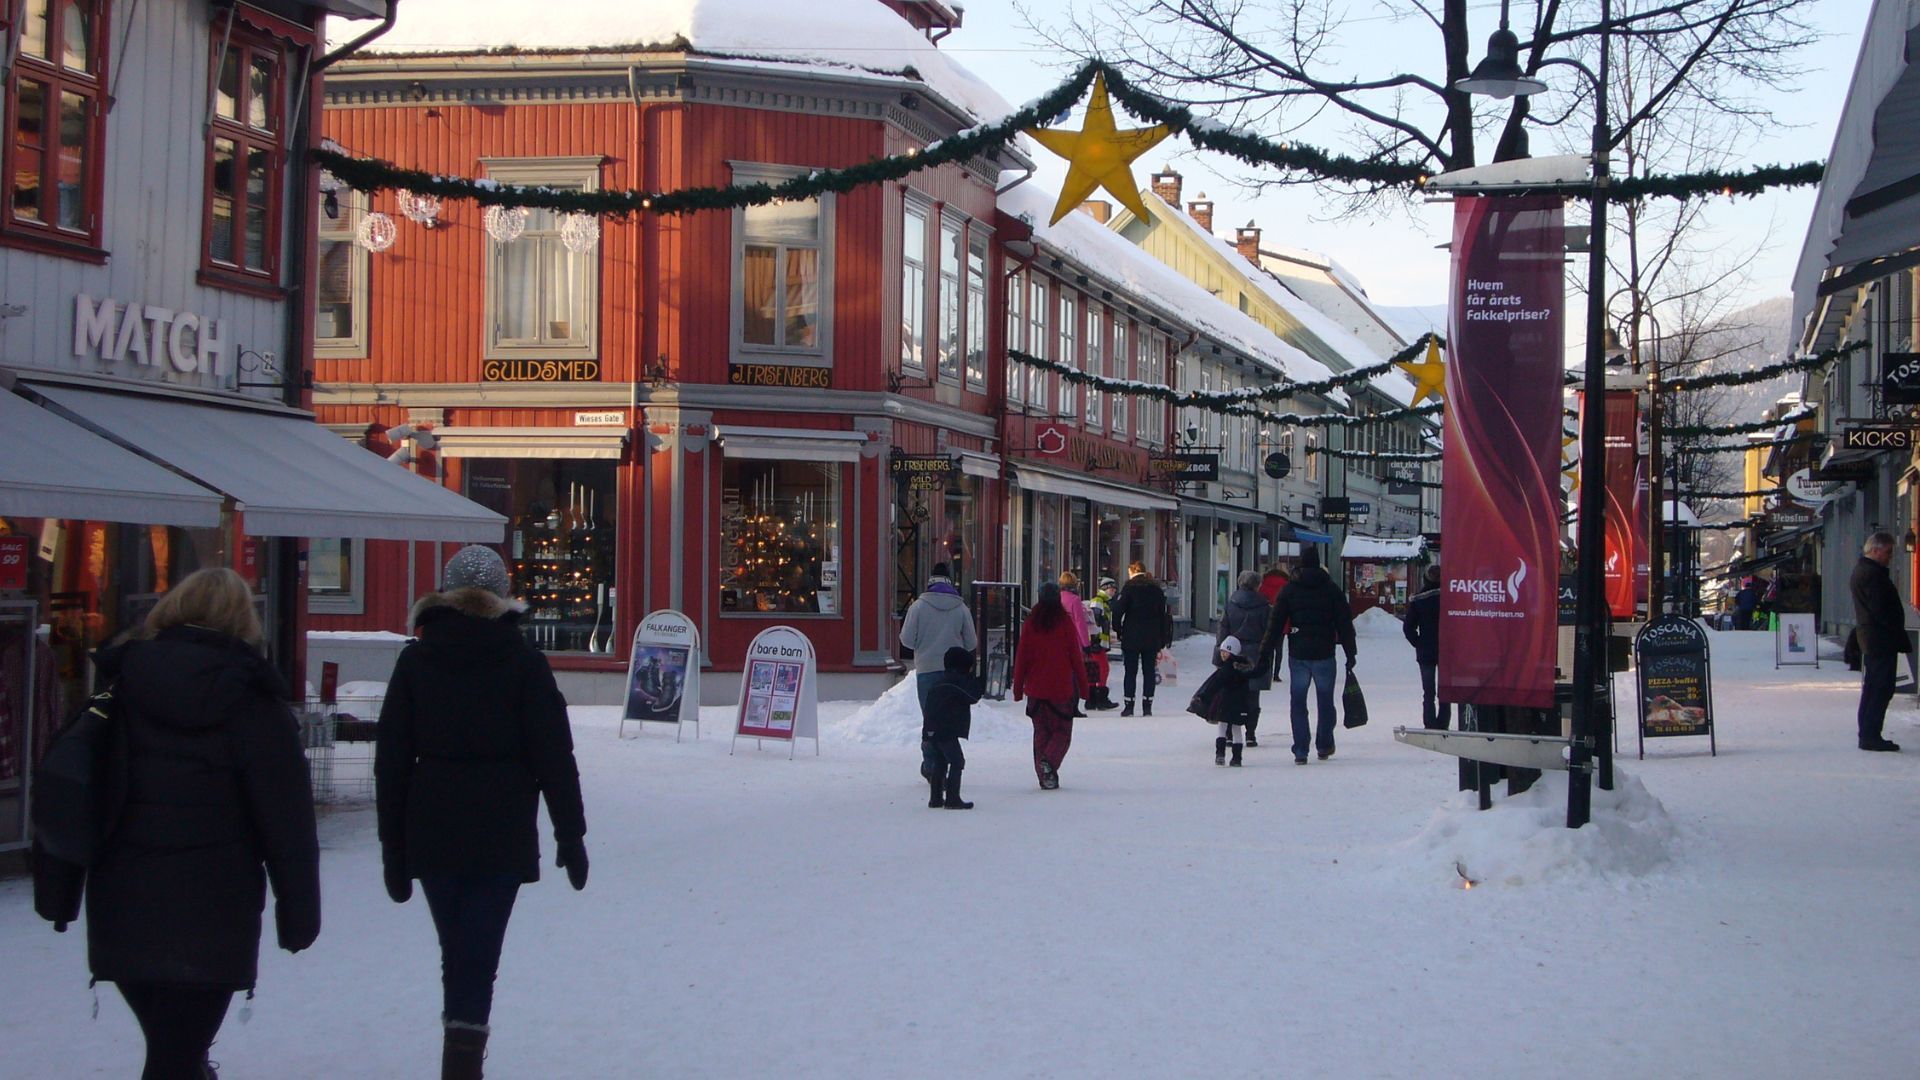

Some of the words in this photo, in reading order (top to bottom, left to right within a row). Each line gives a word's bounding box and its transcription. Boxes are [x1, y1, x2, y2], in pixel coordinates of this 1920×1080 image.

[1468, 279, 1503, 290] Hvem
[1467, 293, 1486, 305] får
[1489, 293, 1522, 305] årets
[1466, 309, 1550, 323] Fakkelpriser?
[74, 293, 227, 376] MATCH
[484, 360, 598, 381] GULDSMED
[579, 413, 602, 422] Wieses
[604, 413, 620, 422] Gate
[1849, 431, 1905, 447] KICKS
[1450, 579, 1506, 593] FAKKEL
[1472, 593, 1506, 602] PRISEN
[1448, 609, 1525, 618] www.fakkelprisen.no
[646, 623, 688, 634] FALKANGER
[1641, 623, 1697, 642] TOSCANA
[757, 643, 778, 655] bare
[780, 645, 803, 658] barn
[1648, 657, 1698, 674] TOSCANA
